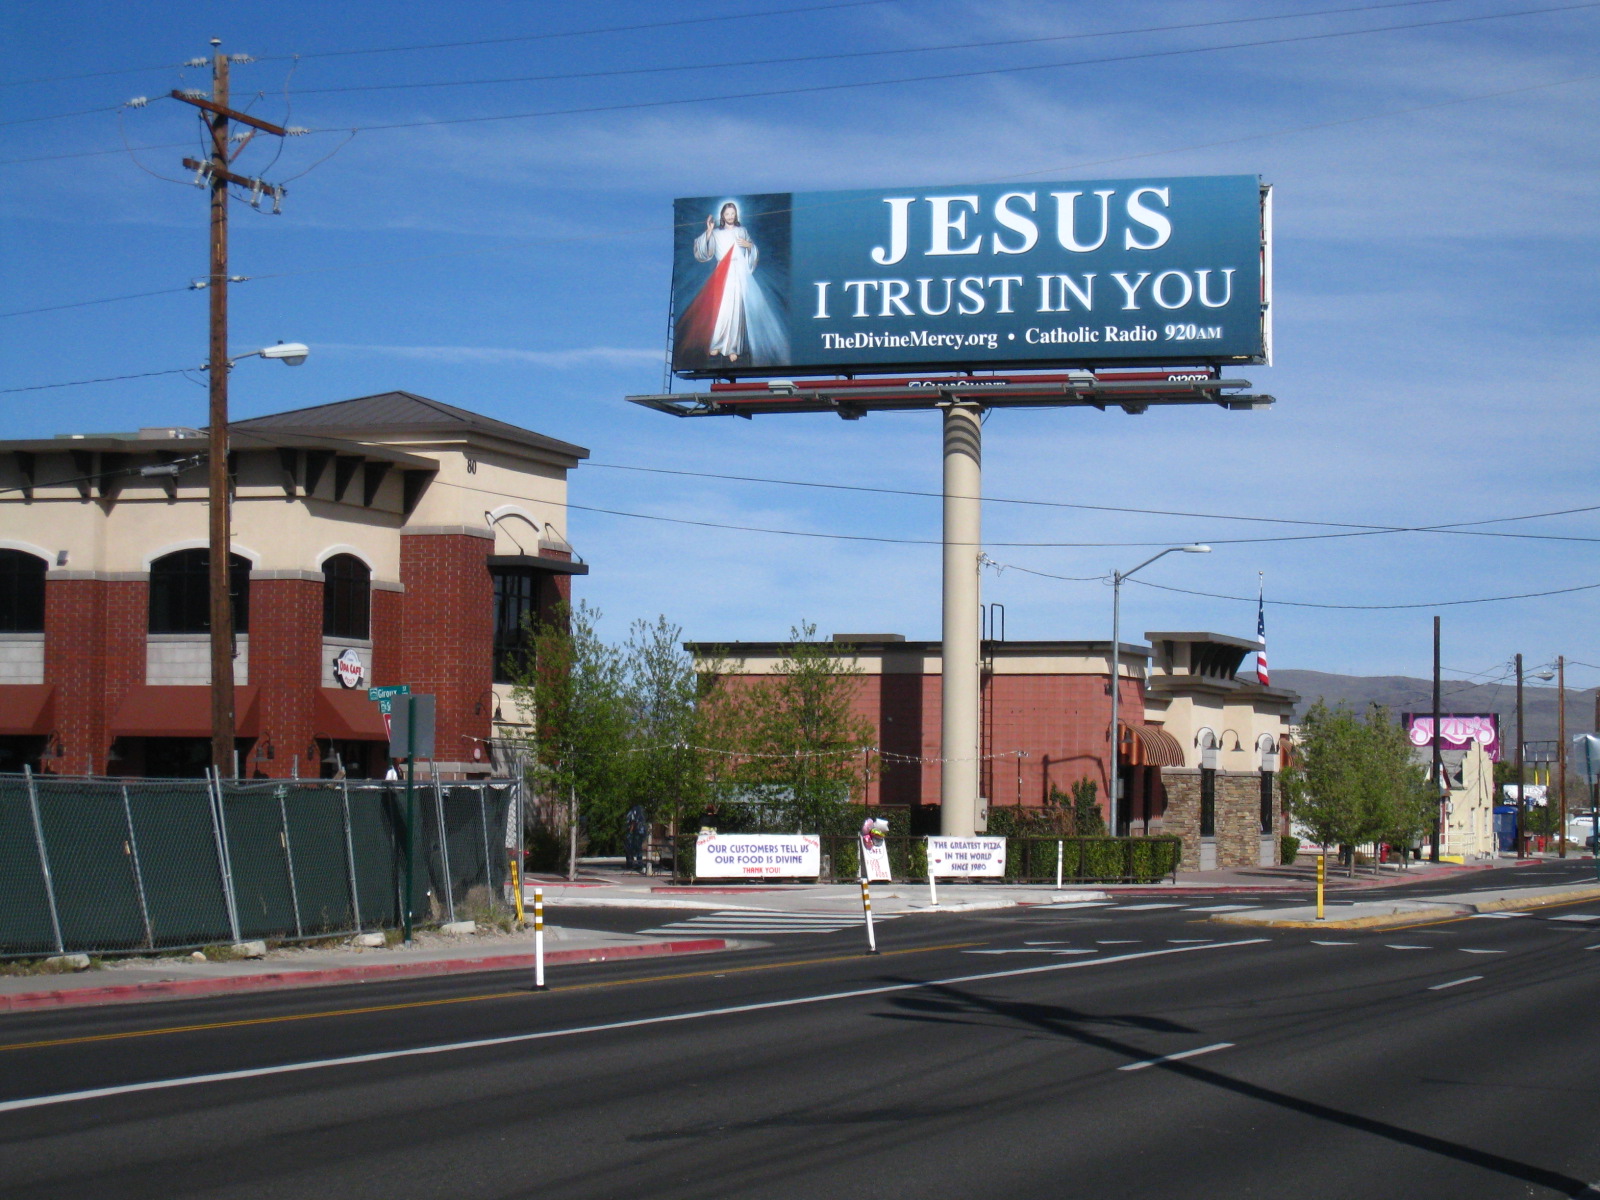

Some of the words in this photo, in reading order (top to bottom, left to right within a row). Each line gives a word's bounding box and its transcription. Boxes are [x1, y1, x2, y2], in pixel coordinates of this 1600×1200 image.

[871, 187, 1172, 265] JESUS
[813, 282, 831, 319] I
[844, 276, 1024, 319] TRUST
[1036, 273, 1098, 313] IN
[1110, 269, 1237, 310] YOU
[821, 330, 998, 350] TheDivineMercy.org
[1025, 326, 1100, 345] Catholic
[1104, 325, 1158, 343] Radio
[1164, 323, 1222, 341] 920AM
[707, 844, 727, 853] OUR
[730, 844, 779, 853] CUSTOMERS
[780, 844, 799, 853] TELL
[800, 844, 809, 853] US
[934, 841, 948, 849] THE
[950, 842, 981, 850] GREATEST
[983, 842, 1002, 850] PIZZA
[715, 855, 735, 864] OUR
[737, 855, 764, 864] FOOD
[766, 855, 774, 864] IS
[776, 855, 803, 864] DIVINE
[945, 852, 953, 860] IN
[955, 852, 968, 860] THE
[969, 852, 992, 860] WORLD
[951, 863, 969, 871] SINCE
[971, 863, 987, 871] 1980
